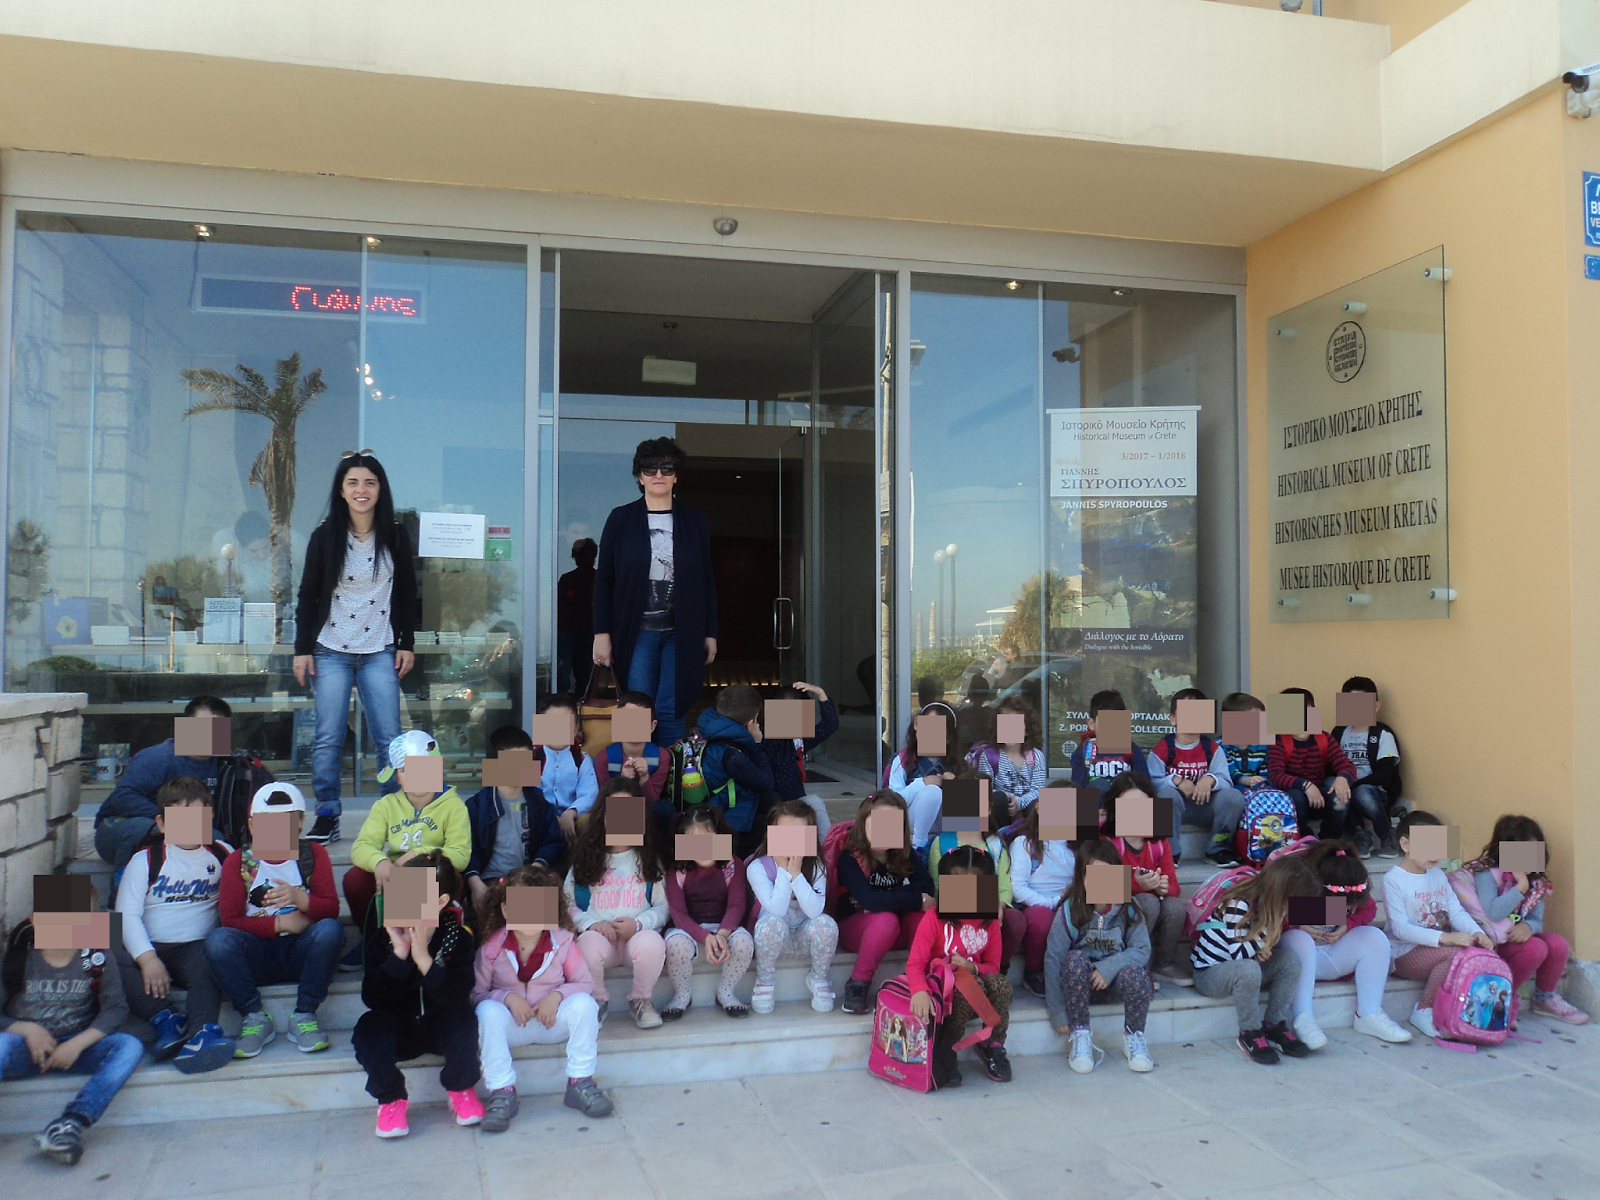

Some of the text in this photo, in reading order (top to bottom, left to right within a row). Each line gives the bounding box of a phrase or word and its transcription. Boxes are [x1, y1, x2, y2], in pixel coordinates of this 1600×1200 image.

[1061, 418, 1186, 432] Ιστορικό Μουσείο Κρήτης
[1283, 390, 1423, 449] ΙΣΤΟΡΙΚΟ ΜΟΥΣΕΙΟ ΚΡΗΤΗΣ
[1073, 432, 1110, 441] Historical
[1112, 432, 1146, 440] Museum
[1154, 431, 1177, 440] Crete
[1121, 452, 1149, 461] 3/2017
[1158, 451, 1186, 460] 1/2018
[1061, 468, 1100, 476] ΓΙΑΝΝΗΣ
[1277, 444, 1431, 497] HISTORICAL MUSEUM OF CRETE
[1061, 477, 1187, 490] ΣΠΥΡΟΠΟΥΛΟΣ
[1061, 500, 1168, 509] JANNIS SPYROPOULOS
[1275, 497, 1438, 544] HISTORISCHES MUSEUM KRETAS
[1280, 554, 1431, 591] MUSEE HISTORIQUE DE CRETE
[1084, 631, 1185, 643] Διάλογος με το Αόρατο
[1066, 711, 1171, 721] ΣΥΛΛ ΟΡΤΑΛΑΚ
[1070, 723, 1089, 732] POR
[597, 890, 621, 909] GOOD
[622, 889, 643, 909] IDEA
